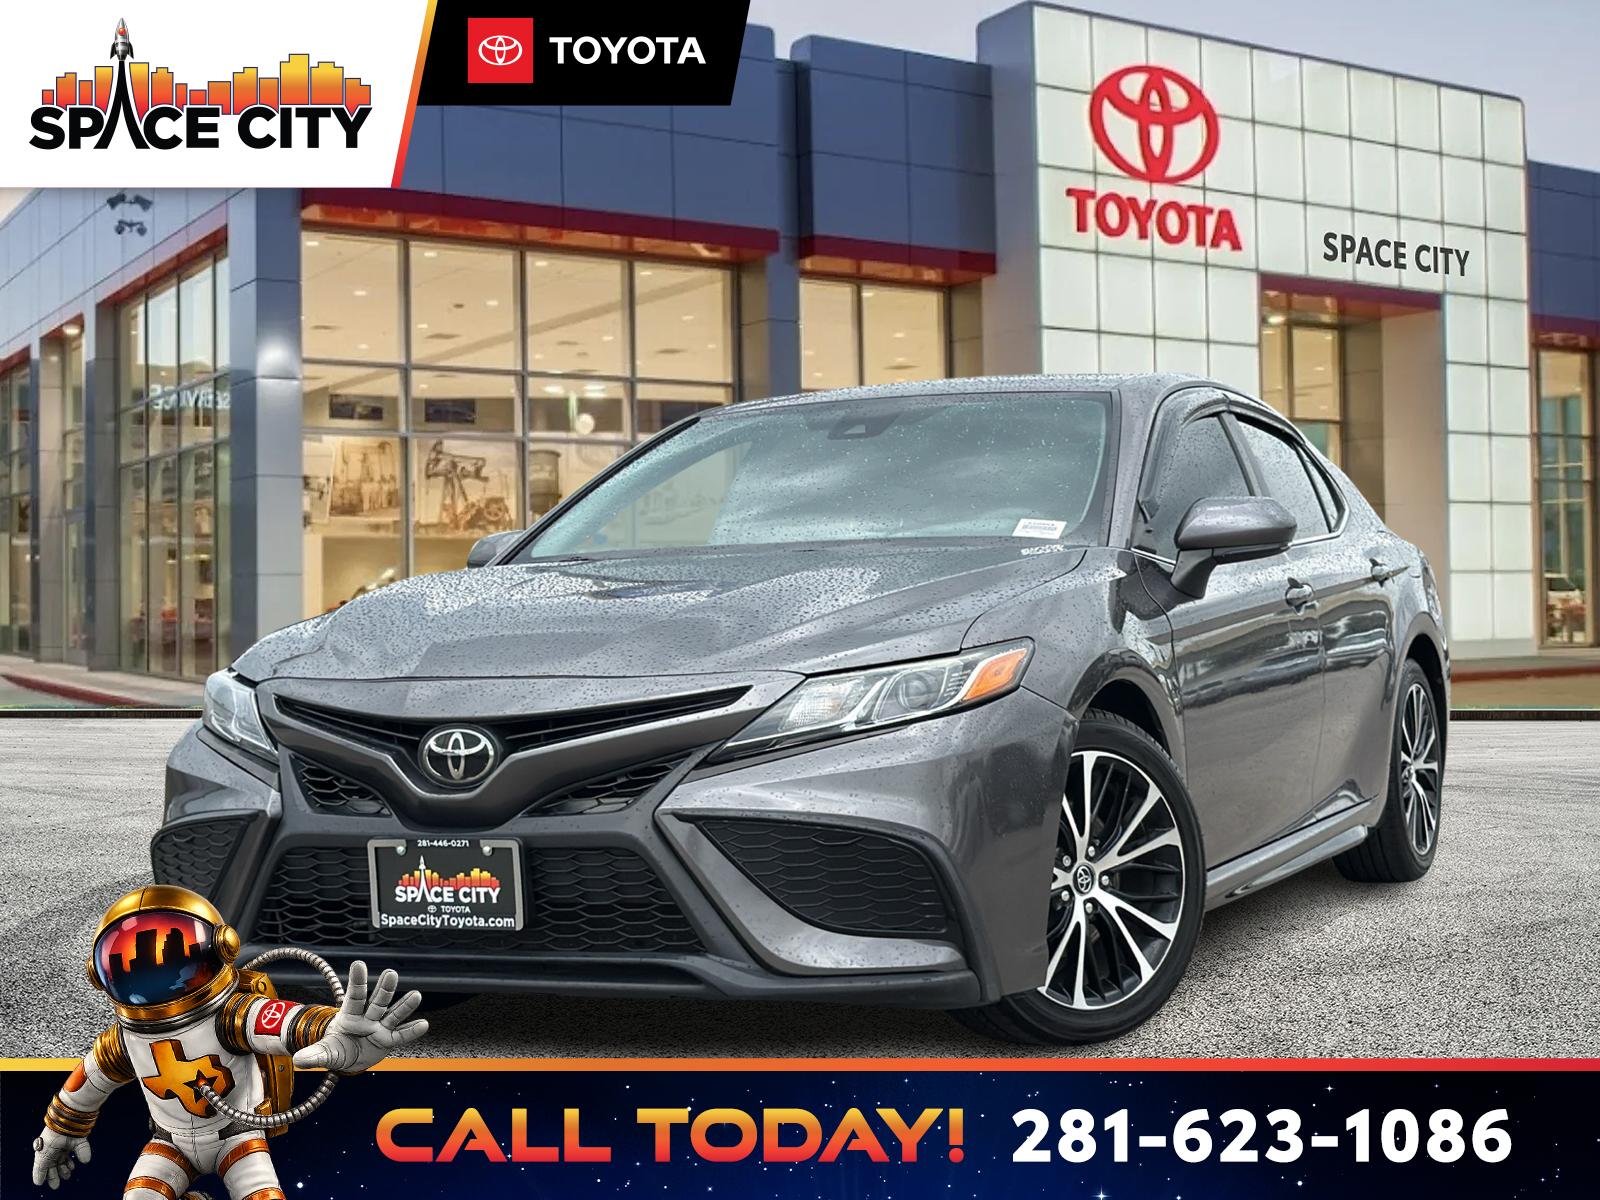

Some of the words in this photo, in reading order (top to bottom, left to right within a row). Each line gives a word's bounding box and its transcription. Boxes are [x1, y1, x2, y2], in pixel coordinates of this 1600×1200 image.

[1066, 187, 1242, 252] TOYOTA
[1322, 232, 1407, 270] SPACE
[1414, 244, 1470, 277] CITY
[417, 839, 470, 848] 281-446-0271
[395, 885, 455, 904] SPACE
[458, 885, 501, 904] CITY
[440, 905, 471, 914] TOYOTA
[380, 913, 515, 929] SpaceCityToyota.com
